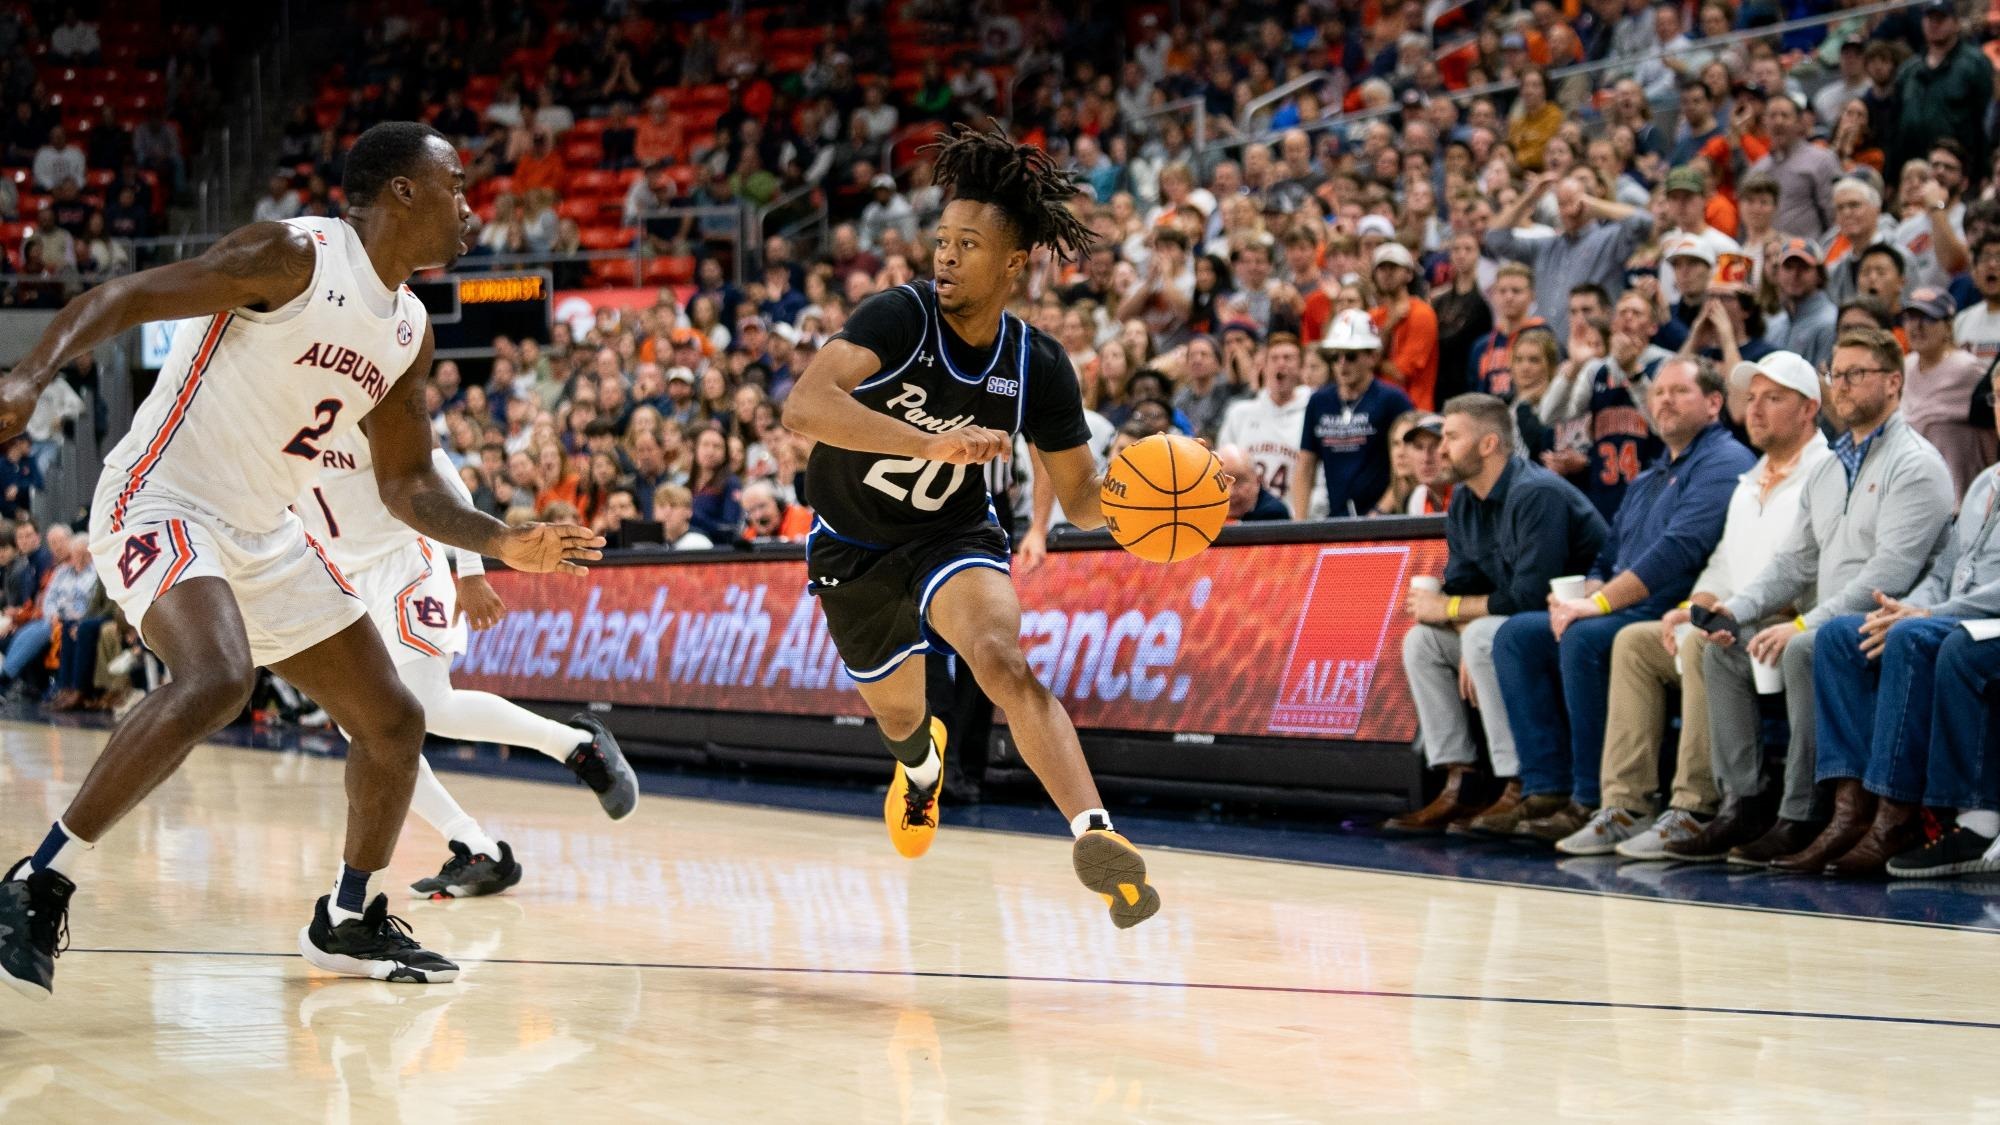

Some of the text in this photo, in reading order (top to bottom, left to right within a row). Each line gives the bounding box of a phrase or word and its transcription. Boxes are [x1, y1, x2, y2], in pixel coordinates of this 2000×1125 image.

[293, 342, 388, 405] AUBURN
[282, 398, 343, 461] 2
[886, 382, 976, 434] Pant
[323, 450, 356, 469] RN
[863, 456, 967, 512] 20
[1102, 464, 1127, 499] son
[1599, 441, 1640, 485] 34
[313, 487, 340, 538] 1
[450, 610, 574, 678] ounce
[567, 585, 675, 682] back
[669, 584, 771, 687] with
[1019, 609, 1192, 703] ance.
[1289, 660, 1368, 705] ALFA
